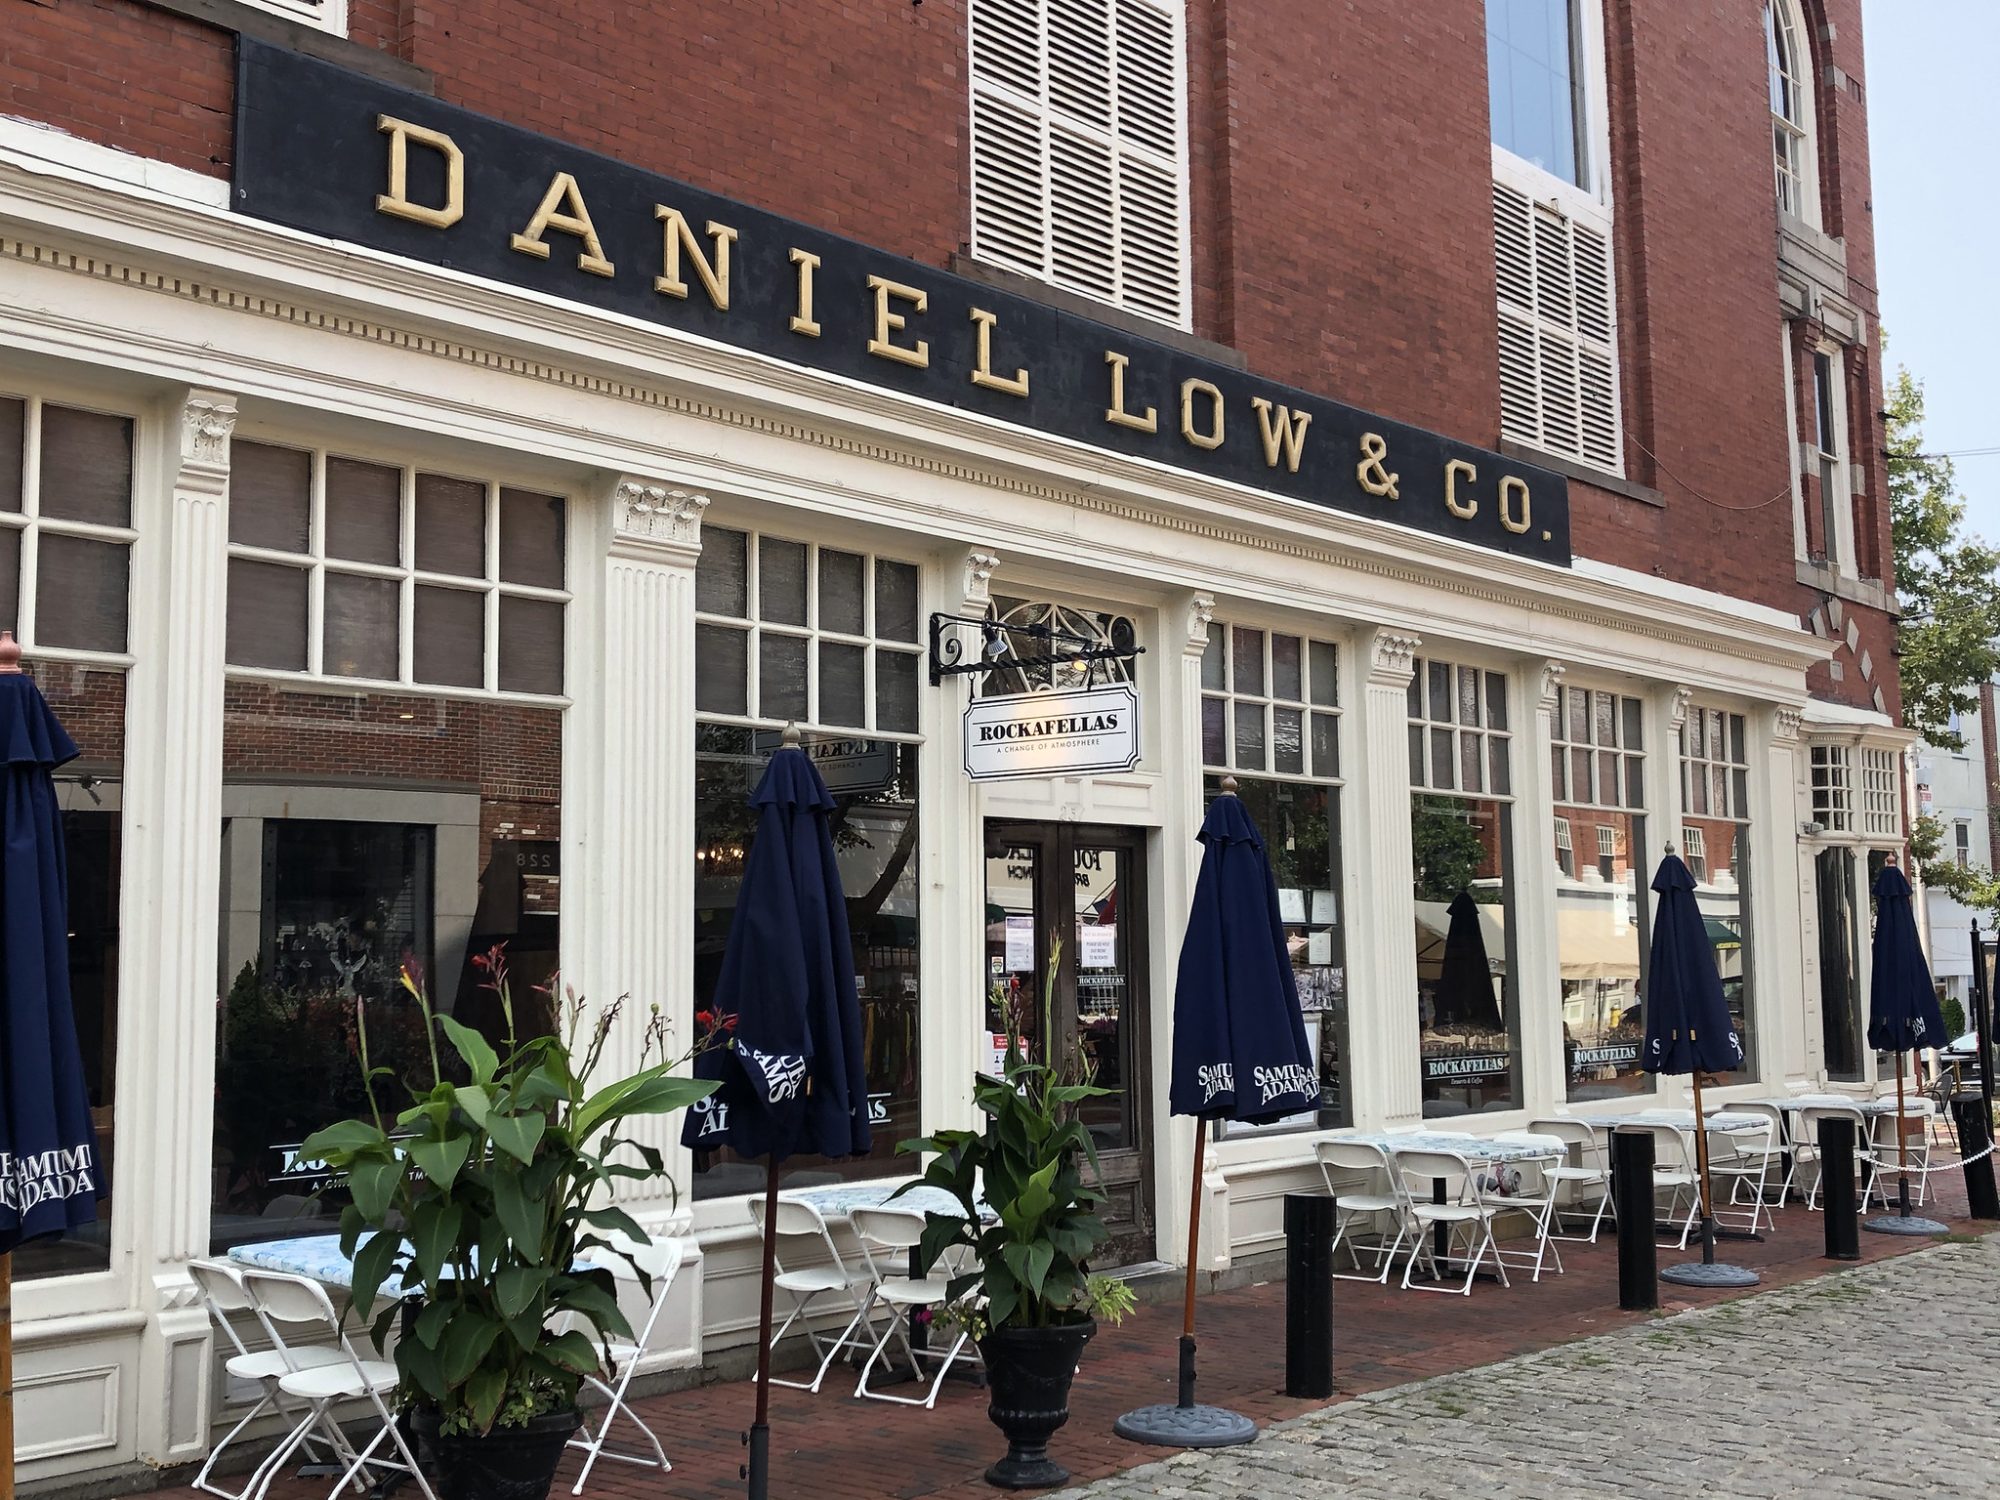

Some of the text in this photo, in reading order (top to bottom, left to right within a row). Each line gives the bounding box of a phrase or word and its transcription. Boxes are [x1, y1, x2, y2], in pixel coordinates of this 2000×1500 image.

[376, 113, 1551, 541] DANIEL LOW & CO.
[980, 714, 1118, 741] ROCKAFELLAS
[1004, 745, 1035, 753] CHANGE
[1051, 738, 1100, 749] ATMOSPHERE
[1428, 1057, 1504, 1076] ROCKAFELLAS
[1574, 1047, 1636, 1063] ROCKAFELLAS
[1253, 1064, 1300, 1087] SAMU
[1261, 1079, 1304, 1106] ADAM
